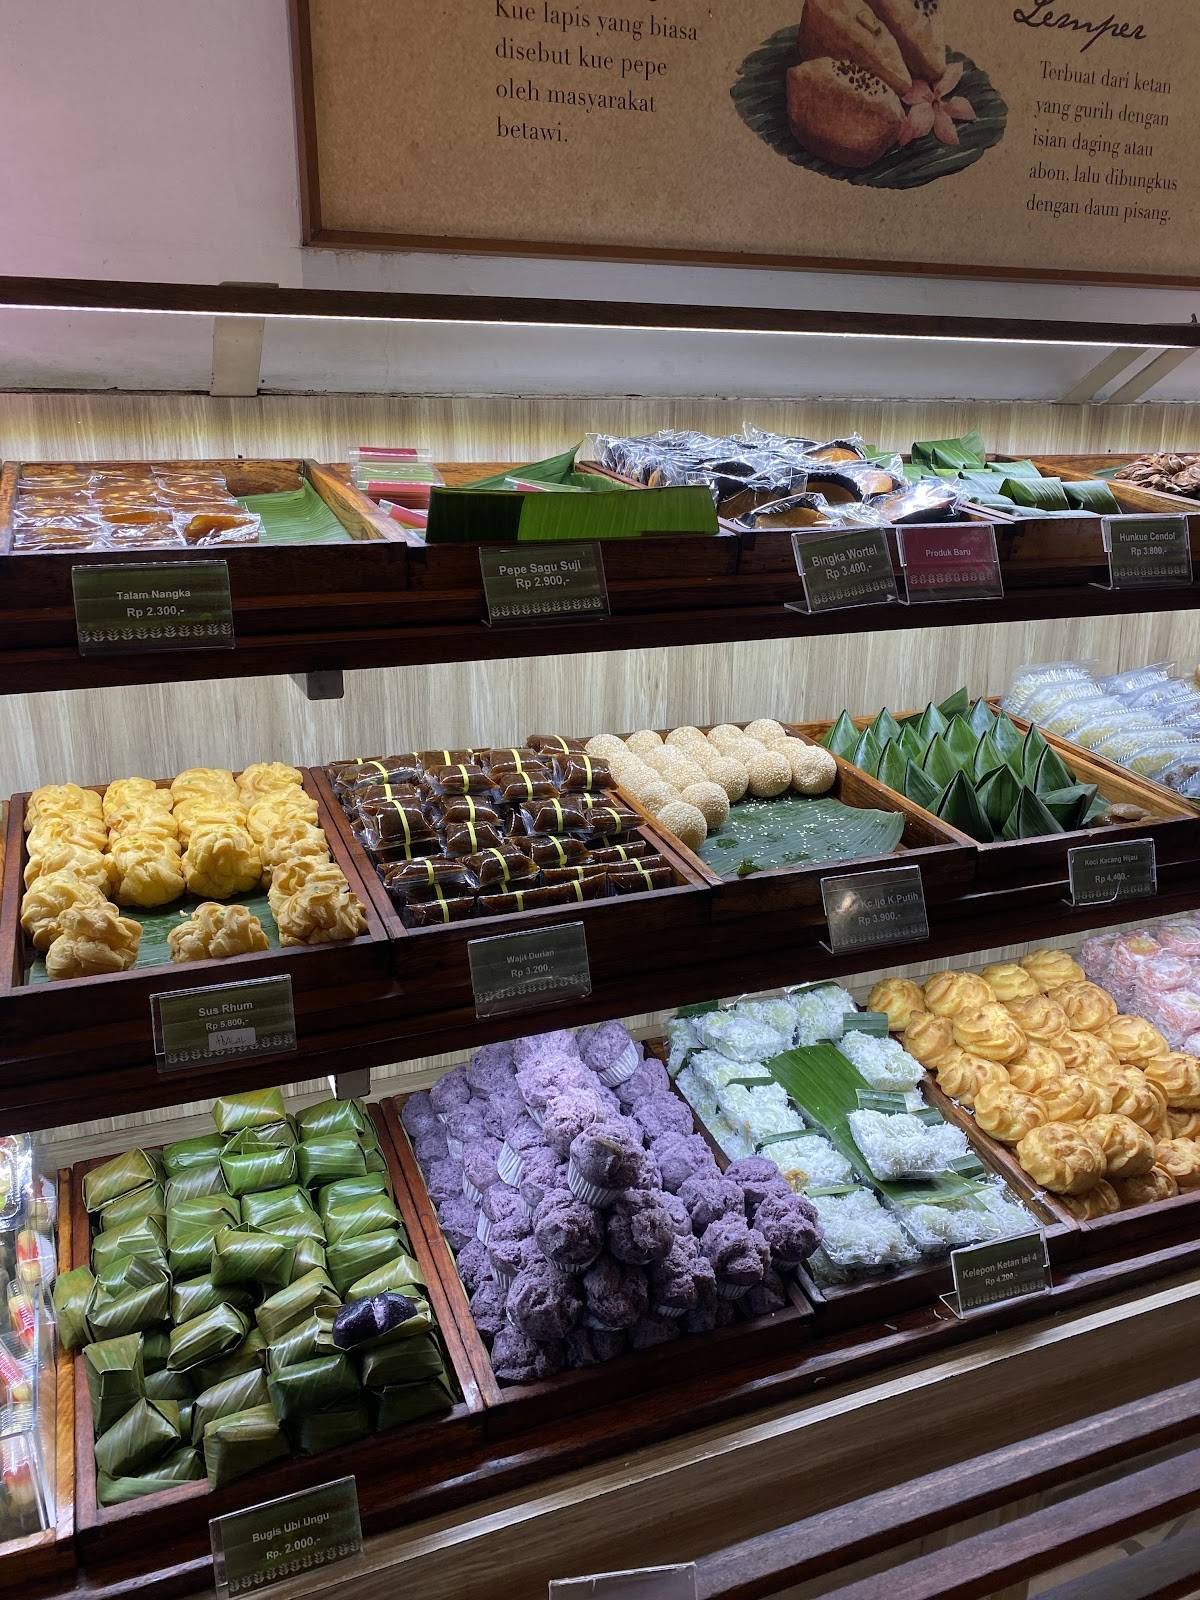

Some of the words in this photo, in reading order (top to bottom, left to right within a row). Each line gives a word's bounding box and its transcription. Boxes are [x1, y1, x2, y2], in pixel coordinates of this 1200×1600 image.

[495, 0, 535, 20] Kue
[544, 2, 590, 32] lapis
[597, 15, 643, 40] yang
[651, 15, 697, 40] biasa
[1013, 0, 1147, 52] Lemper
[496, 37, 571, 66] disebut
[579, 46, 613, 70] kue
[621, 57, 668, 80] pepe
[1040, 60, 1096, 85] Terbuat
[1101, 69, 1129, 89] dari
[1134, 72, 1171, 94] ketan
[496, 78, 539, 102] oleh
[549, 87, 657, 113] masyarakat
[1034, 100, 1071, 120] yang
[1074, 101, 1113, 122] gurih
[1119, 105, 1169, 129] dengan
[497, 117, 568, 142] betawi.
[1033, 128, 1067, 148] isian
[1072, 132, 1121, 158] daging
[1124, 142, 1153, 157] atau
[1029, 162, 1070, 182] abon,
[1074, 164, 1100, 184] lalu
[1105, 168, 1177, 194] dibungkus
[1026, 194, 1079, 218] dengan
[1084, 198, 1119, 216] daun
[1124, 201, 1171, 225] pisang.
[1150, 531, 1176, 541] Cendol
[812, 551, 845, 568] Bingka
[847, 544, 877, 560] Wortel
[926, 548, 951, 557] Produk
[954, 548, 971, 556] Baru
[1131, 547, 1141, 556] Rp
[499, 565, 527, 576] Pepe
[530, 563, 557, 574] Sagu
[560, 560, 581, 572] Suji
[826, 568, 840, 581] Rp
[842, 562, 872, 577] 3.400,-
[516, 578, 531, 589] Rp
[535, 575, 570, 587] 2.900,-
[116, 591, 149, 601] Talam
[151, 589, 191, 600] Nangka
[127, 607, 143, 618] Rp
[146, 606, 185, 617] 2.300,-
[1095, 875, 1106, 884] Rp
[858, 916, 871, 926] Rp
[529, 950, 554, 960] Durian
[511, 969, 523, 978] Rp
[199, 1007, 219, 1017] Sus
[222, 1002, 253, 1013] Rhum
[206, 1021, 218, 1031] Rp
[962, 1264, 995, 1279] Kelepon
[997, 1259, 1020, 1271] Ketan
[985, 1278, 995, 1286] Rp
[252, 1528, 281, 1543] Bugis
[284, 1520, 300, 1533] Ubi
[304, 1512, 329, 1525] Ungu
[266, 1549, 282, 1560] Rp.
